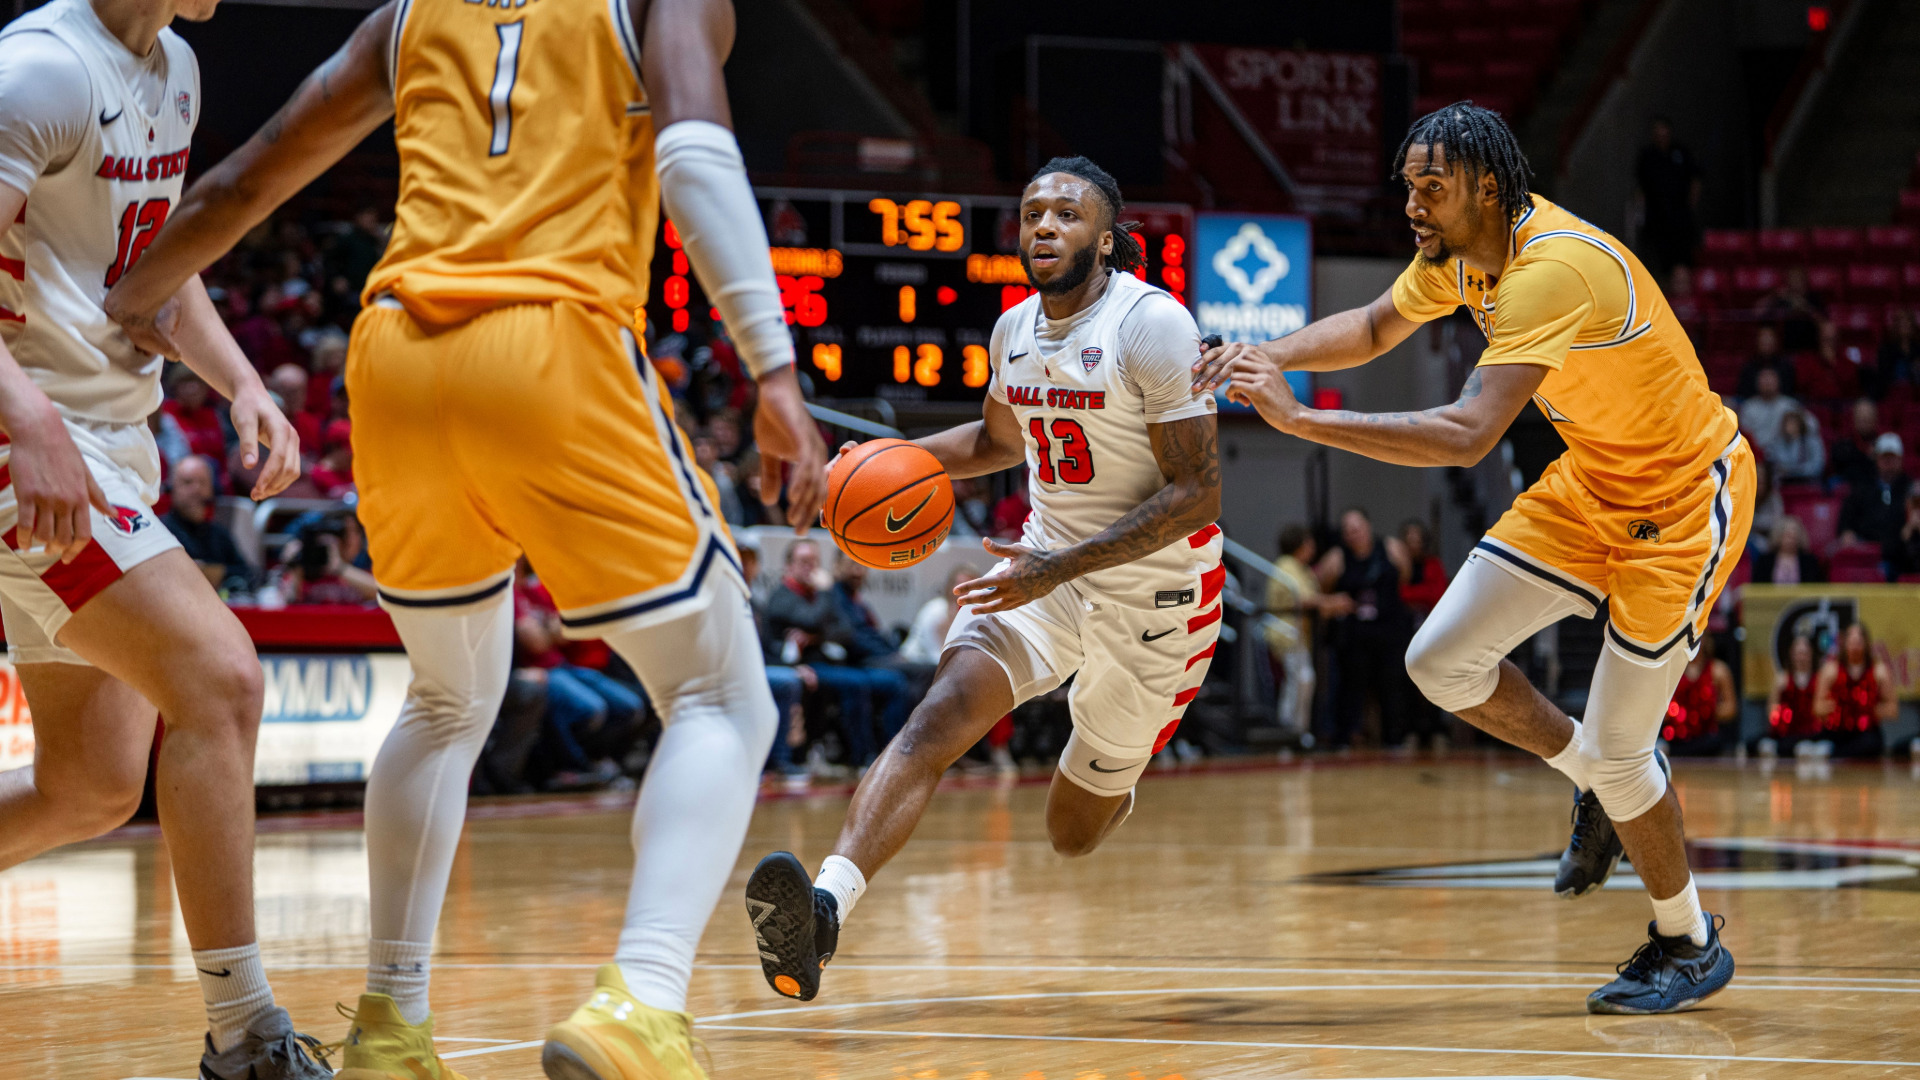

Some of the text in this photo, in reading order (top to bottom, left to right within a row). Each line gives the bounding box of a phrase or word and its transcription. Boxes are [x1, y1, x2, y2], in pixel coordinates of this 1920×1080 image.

[488, 16, 524, 158] 1
[1227, 51, 1377, 91] SPORTS
[1279, 94, 1373, 133] LINK
[96, 154, 144, 181] BALL
[104, 197, 171, 288] 12
[868, 198, 964, 252] 7:55
[899, 285, 916, 323] 1
[893, 343, 943, 387] 12
[1006, 385, 1105, 410] BALL STATE
[1028, 417, 1095, 485] 13
[889, 524, 950, 563] ELITE
[1182, 594, 1191, 603] M
